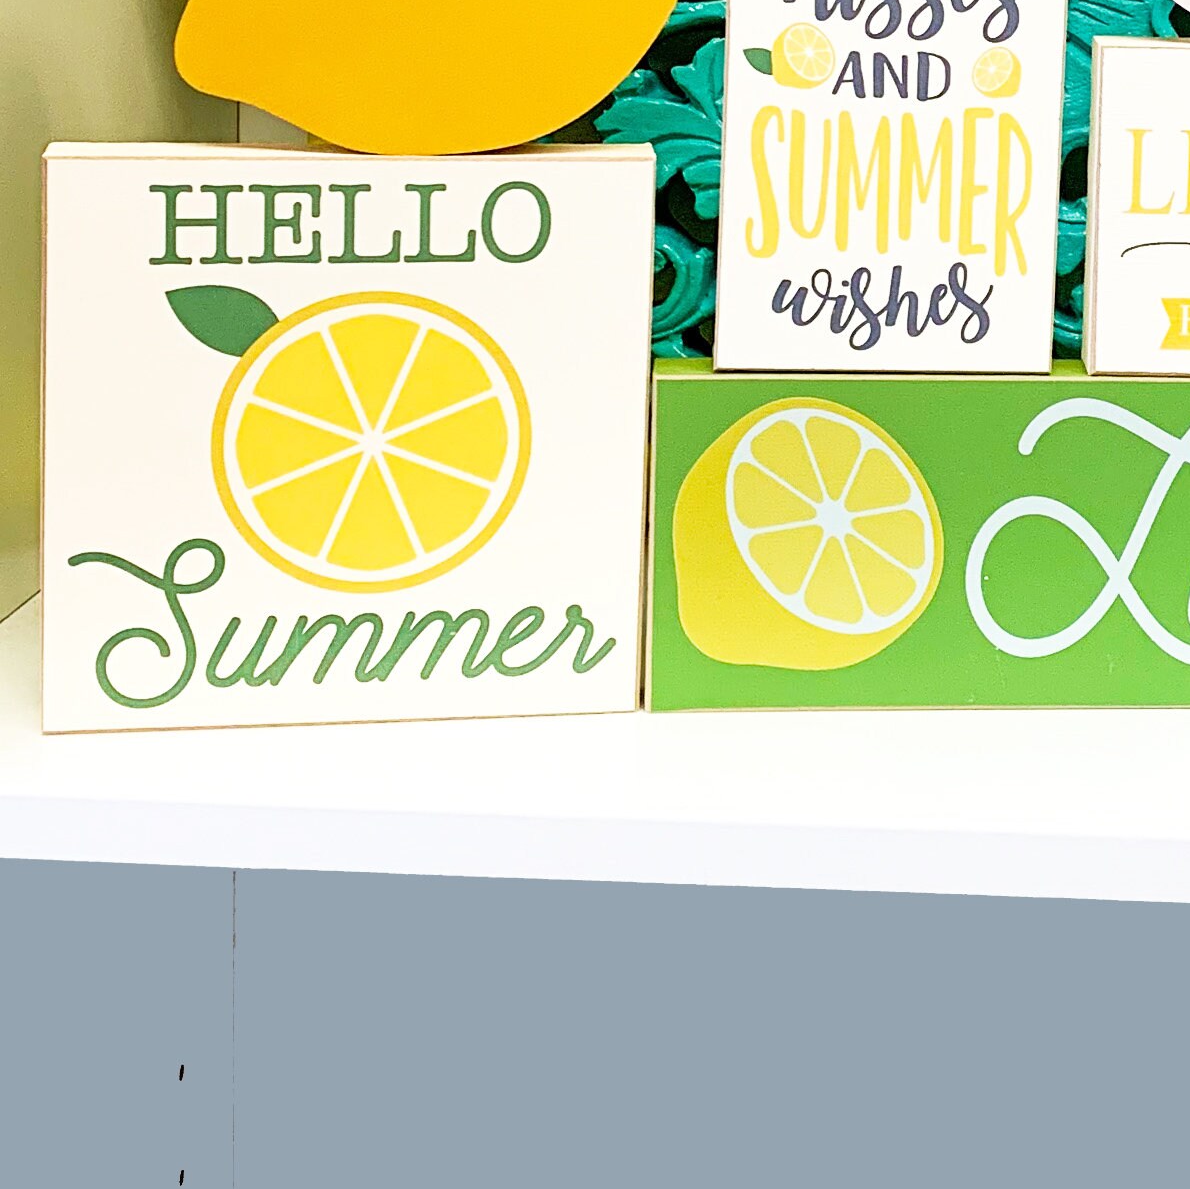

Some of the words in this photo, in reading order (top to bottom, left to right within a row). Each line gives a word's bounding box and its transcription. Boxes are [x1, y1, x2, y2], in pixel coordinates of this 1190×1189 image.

[832, 50, 951, 102] AND
[149, 181, 552, 265] HELLO
[745, 105, 1034, 277] SUMMER
[771, 261, 994, 351] wishes
[68, 538, 617, 709] Summer
